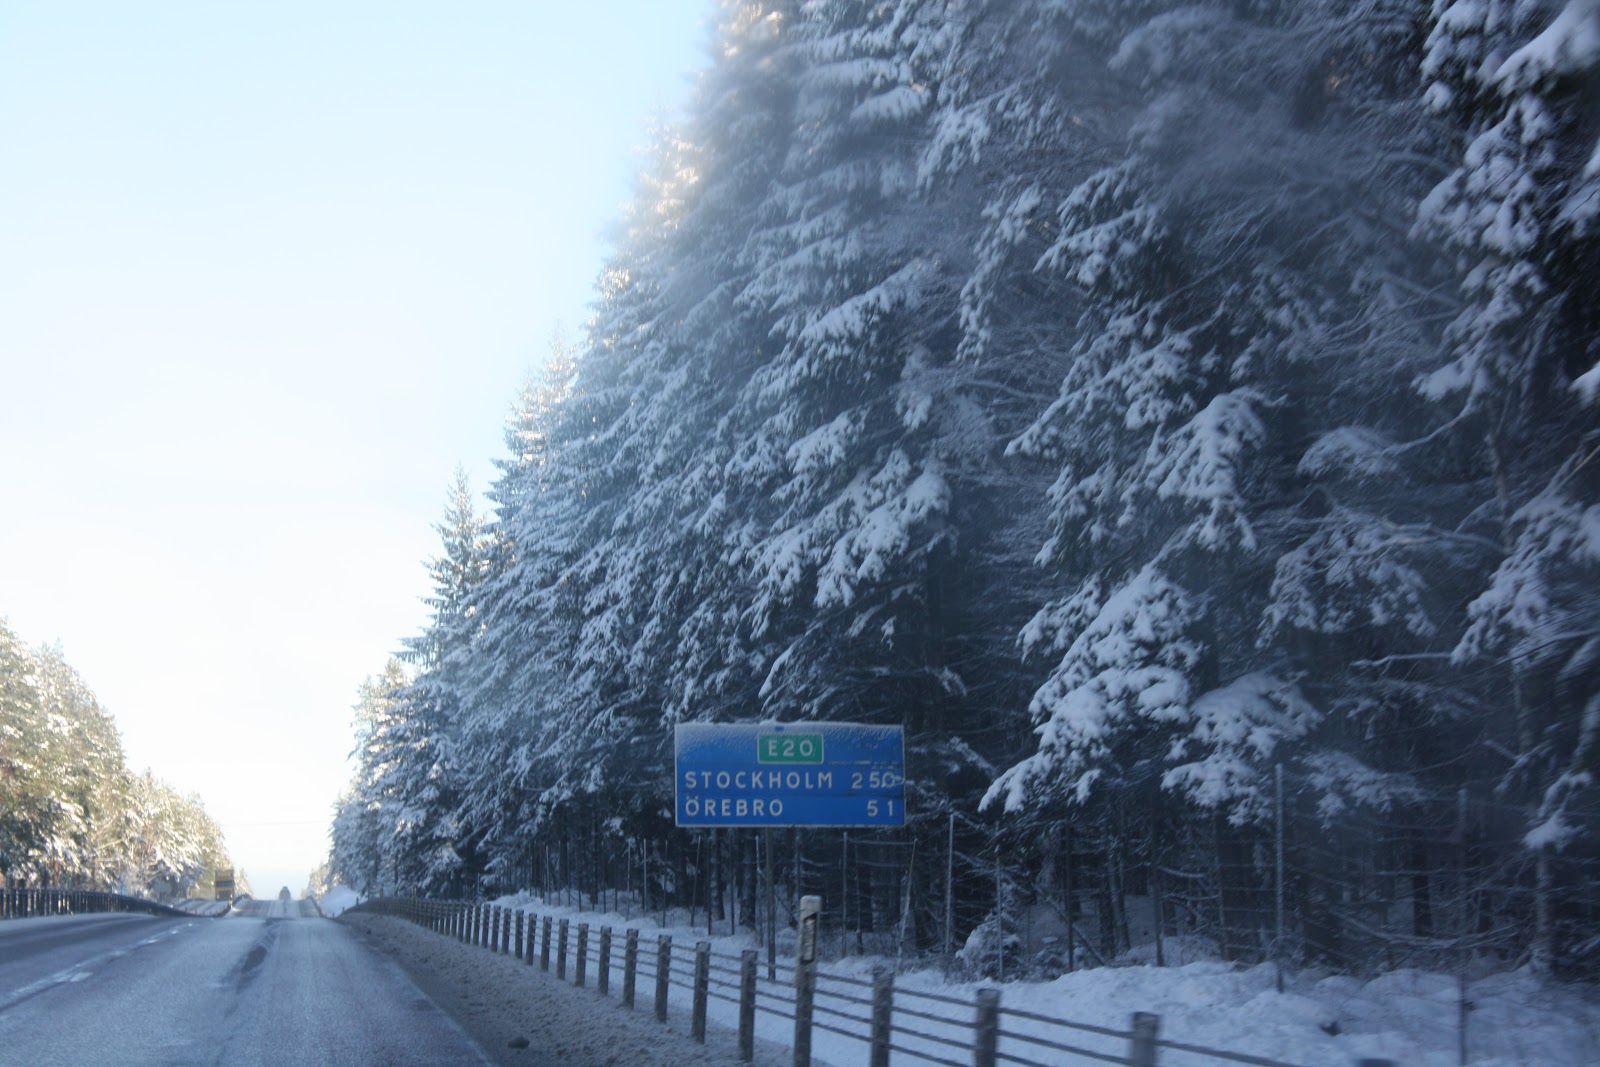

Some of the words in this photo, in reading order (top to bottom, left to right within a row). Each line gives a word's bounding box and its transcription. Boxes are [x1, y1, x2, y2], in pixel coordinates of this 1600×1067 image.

[768, 739, 815, 757] E20
[685, 771, 832, 789] STOCKHOLM
[851, 771, 896, 789] 250
[685, 795, 783, 816] ÖREBRO
[867, 800, 893, 816] 51
